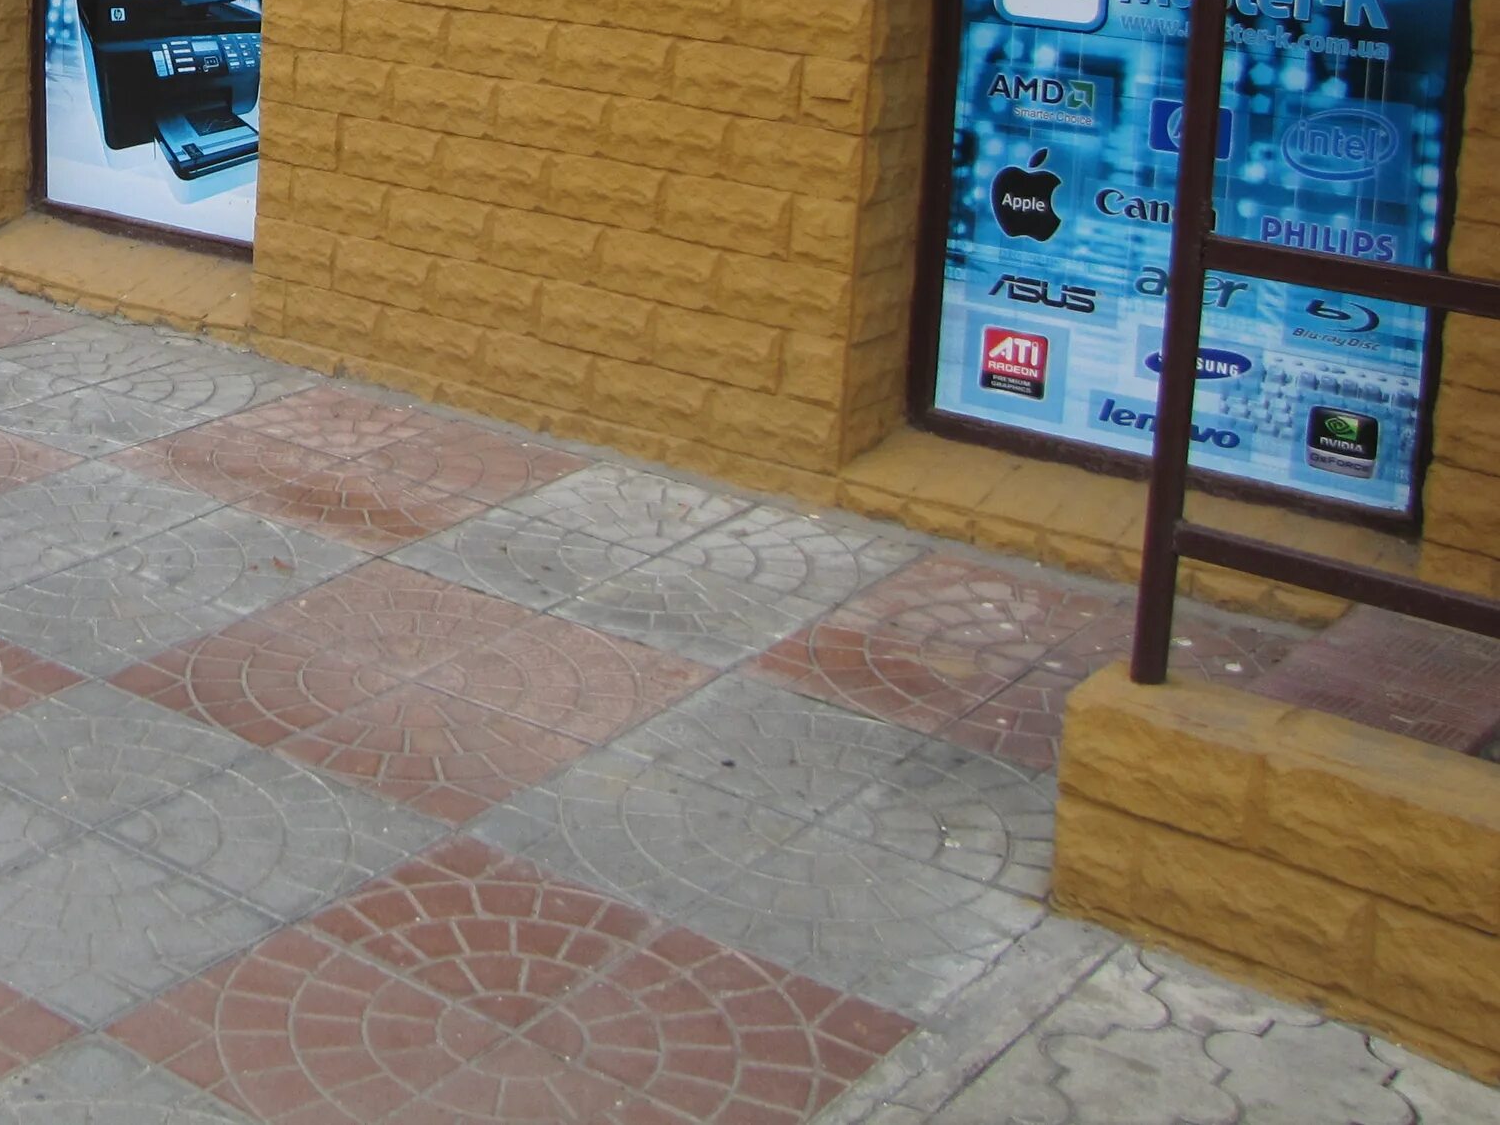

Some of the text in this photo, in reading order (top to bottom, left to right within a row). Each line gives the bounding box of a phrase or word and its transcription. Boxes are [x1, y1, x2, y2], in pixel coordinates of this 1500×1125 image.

[987, 73, 1064, 104] AMD
[1014, 106, 1093, 125] Smarter Choice
[1297, 121, 1377, 163] intel
[1002, 193, 1045, 211] Apple
[1095, 188, 1217, 232] Can
[1261, 216, 1394, 262] PHILIPS
[988, 274, 1097, 314] ASUS
[1135, 266, 1248, 307] aer
[987, 360, 1038, 378] RADEON
[1100, 398, 1240, 449] lenvo
